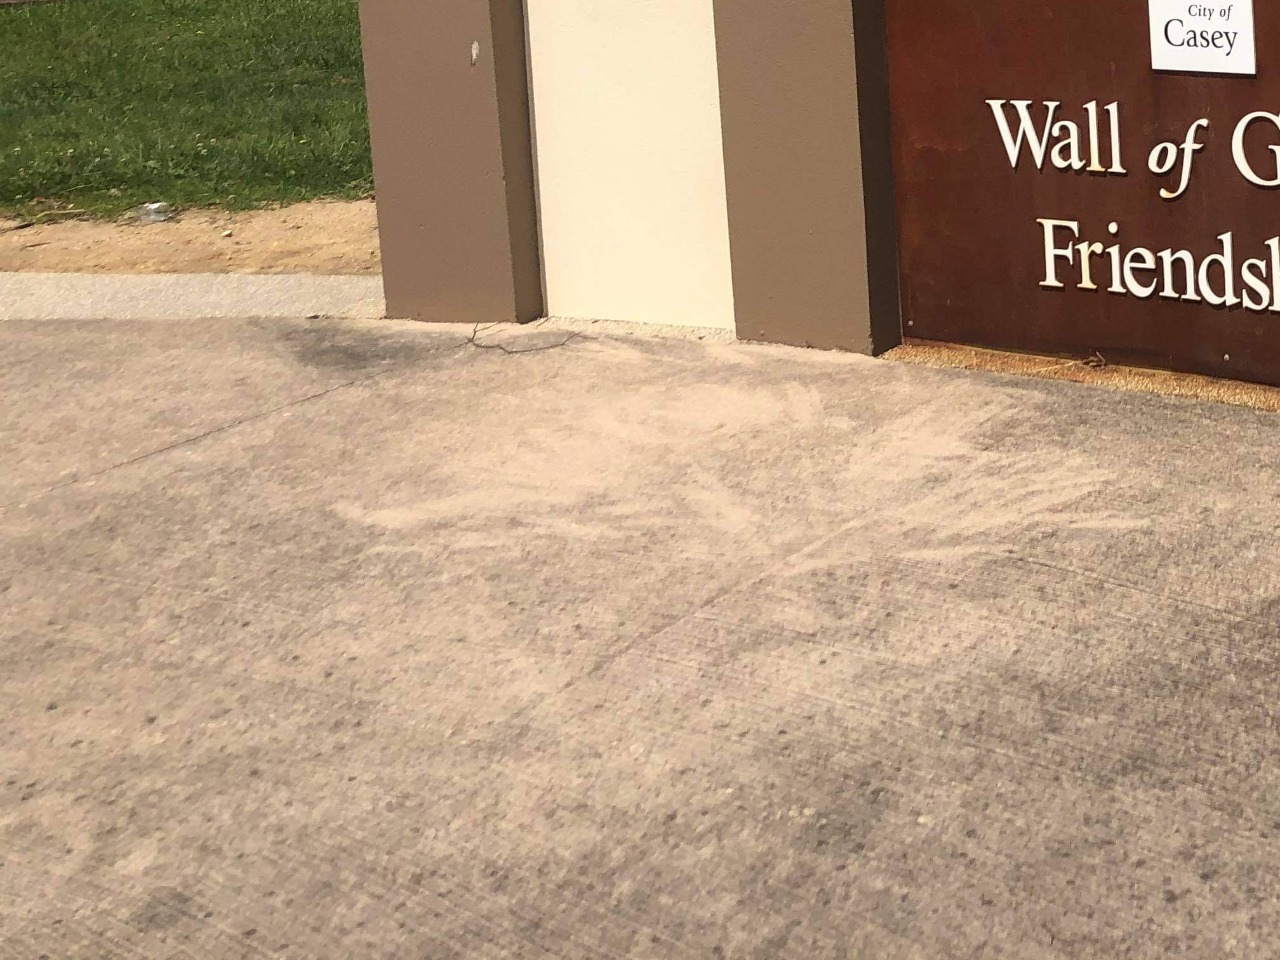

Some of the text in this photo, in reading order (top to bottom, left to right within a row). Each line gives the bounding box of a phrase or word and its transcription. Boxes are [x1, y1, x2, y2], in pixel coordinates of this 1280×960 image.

[1187, 3, 1234, 21] City of
[1163, 18, 1238, 56] Casey
[985, 99, 1127, 174] Wall
[1147, 118, 1209, 198] of
